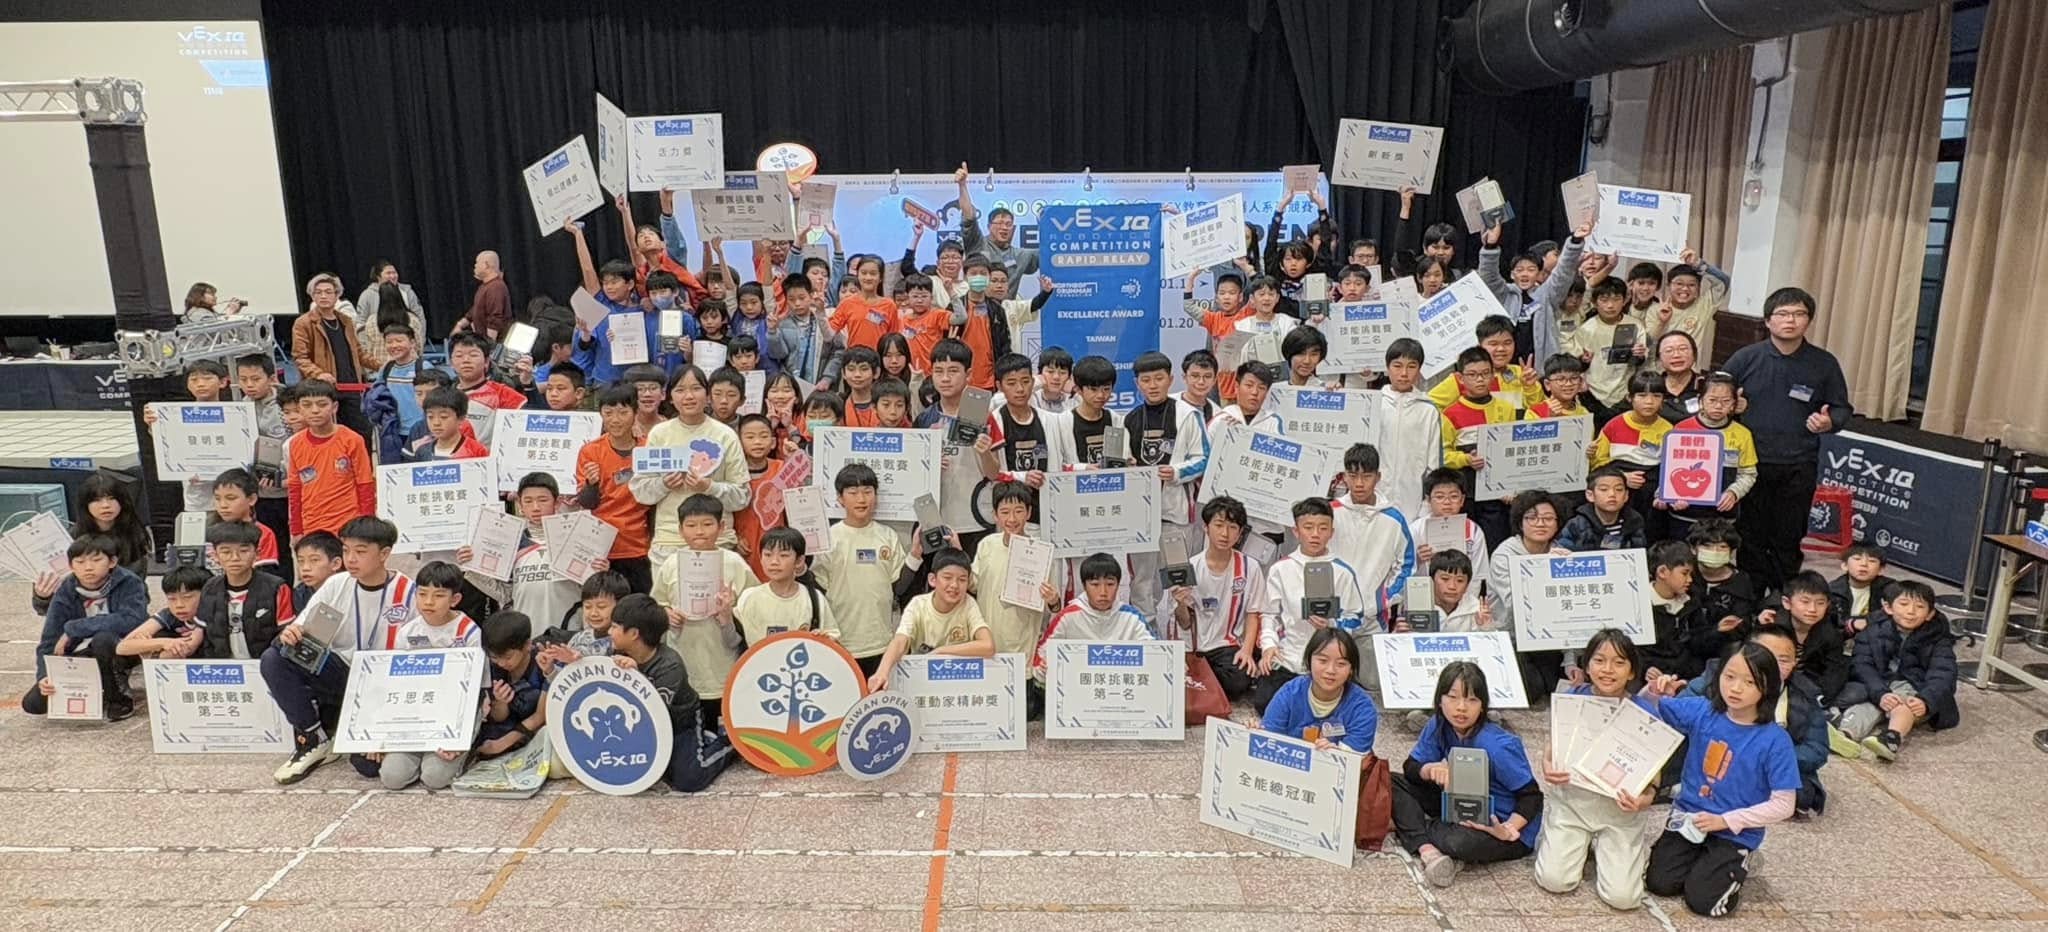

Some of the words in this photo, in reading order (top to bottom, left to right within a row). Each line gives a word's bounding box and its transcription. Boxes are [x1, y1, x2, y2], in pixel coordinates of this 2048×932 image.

[1050, 208, 1117, 231] VEX
[1120, 215, 1150, 231] IQ
[1050, 241, 1151, 251] COMPETITION
[1058, 255, 1097, 265] RAPID
[1103, 254, 1144, 264] RELAY
[1160, 278, 1185, 289] 01.1
[1057, 310, 1110, 319] EXCELLENCE
[1111, 309, 1144, 318] AWARD
[1348, 305, 1370, 314] VEX
[1159, 317, 1194, 328] 01.20
[94, 369, 127, 386] VE
[1300, 391, 1328, 402] VEX
[184, 406, 208, 415] VEX
[531, 413, 554, 424] VEX
[1288, 420, 1349, 435] 最佳設計獎
[1516, 423, 1541, 433] VEX
[855, 432, 884, 443] VEX
[1257, 436, 1284, 450] VEX
[1286, 444, 1297, 453] IQ
[1505, 442, 1562, 458] 團隊挑戰賽
[527, 450, 559, 461] 第五名
[1516, 456, 1549, 467] 第四名
[415, 463, 443, 477] VEX
[445, 468, 456, 476] IQ
[1827, 448, 1884, 480] VEX
[1885, 467, 1915, 489] IQ
[1080, 474, 1108, 485] VEX
[1248, 470, 1284, 490] 第一名
[1824, 468, 1912, 499] ROBOTICS
[1822, 477, 1910, 510] COMPETITION
[420, 503, 456, 516] 第三名
[1892, 536, 1920, 551] CACET
[1554, 557, 1585, 569] VEX
[1545, 583, 1615, 598] 團隊挑戰賽
[1561, 598, 1602, 611] 第一名
[1418, 636, 1447, 646] VEX
[790, 650, 804, 662] C
[1092, 644, 1123, 656] VEX
[396, 655, 426, 666] VEX
[932, 659, 963, 670] VEX
[191, 664, 223, 675] VEX
[551, 664, 606, 702] TAIWAN
[610, 666, 652, 702] OPEN
[766, 675, 777, 689] A
[811, 675, 819, 689] E
[1080, 673, 1150, 686] 團隊挑戰賽
[181, 691, 254, 703] 團隊挑戰賽
[386, 691, 436, 704] 巧思獎
[1094, 688, 1135, 700] 第一名
[198, 704, 241, 717] 第二名
[769, 701, 781, 714] C
[806, 706, 818, 720] T
[842, 700, 880, 737] TAIWAN
[882, 695, 909, 708] OPEN
[1254, 737, 1289, 754] VEX
[1291, 749, 1306, 760] IQ
[586, 751, 628, 770] VEX
[630, 753, 648, 766] IQ
[864, 750, 892, 769] VEX
[892, 743, 905, 753] IQ
[1238, 770, 1317, 805] 全能總冠軍
